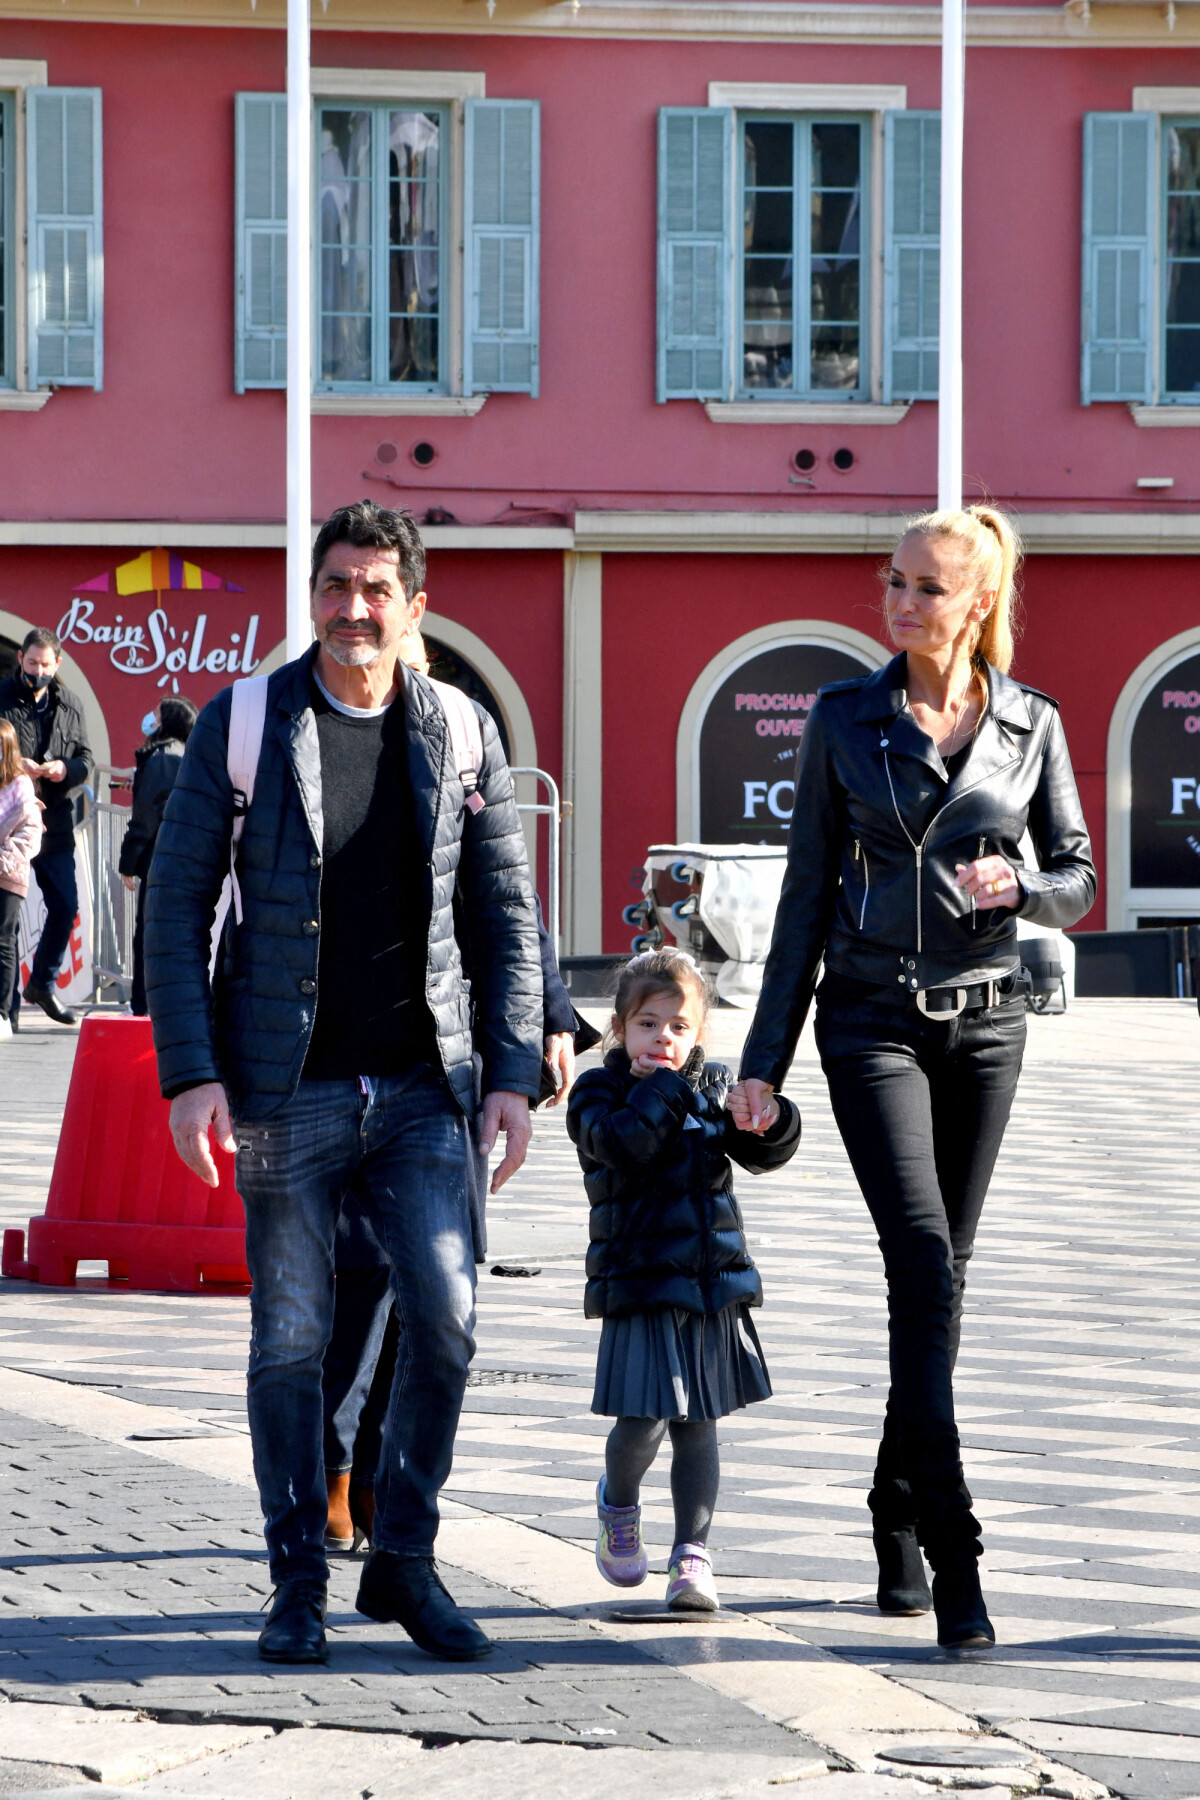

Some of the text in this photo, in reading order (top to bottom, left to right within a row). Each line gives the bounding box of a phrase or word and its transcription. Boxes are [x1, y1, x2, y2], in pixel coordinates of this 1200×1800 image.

[56, 598, 260, 674] Bain de Soleil
[1162, 690, 1200, 708] PRO
